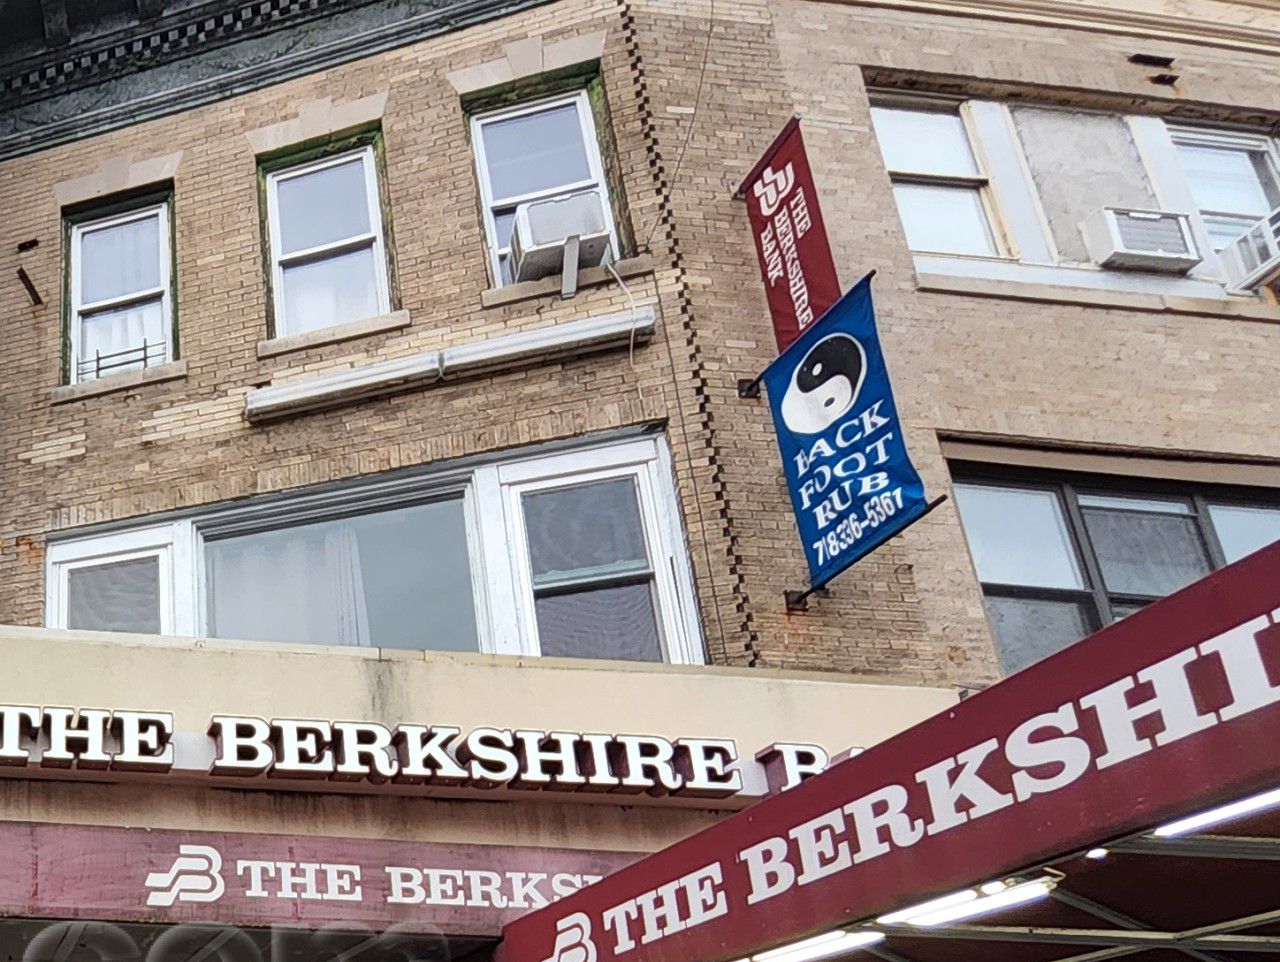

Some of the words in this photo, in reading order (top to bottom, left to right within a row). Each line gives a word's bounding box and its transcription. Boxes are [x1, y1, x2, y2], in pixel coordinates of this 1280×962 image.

[790, 186, 812, 239] THE
[760, 222, 784, 287] BANK
[774, 205, 813, 331] BERKSHIRE
[798, 432, 893, 510] FOOT
[812, 471, 890, 530] RUB
[215, 715, 743, 792] BERKSHIRE
[603, 863, 728, 955] THE
[735, 605, 1280, 906] BERKSHI
[237, 858, 362, 902] THE
[385, 866, 603, 910] BERKS
